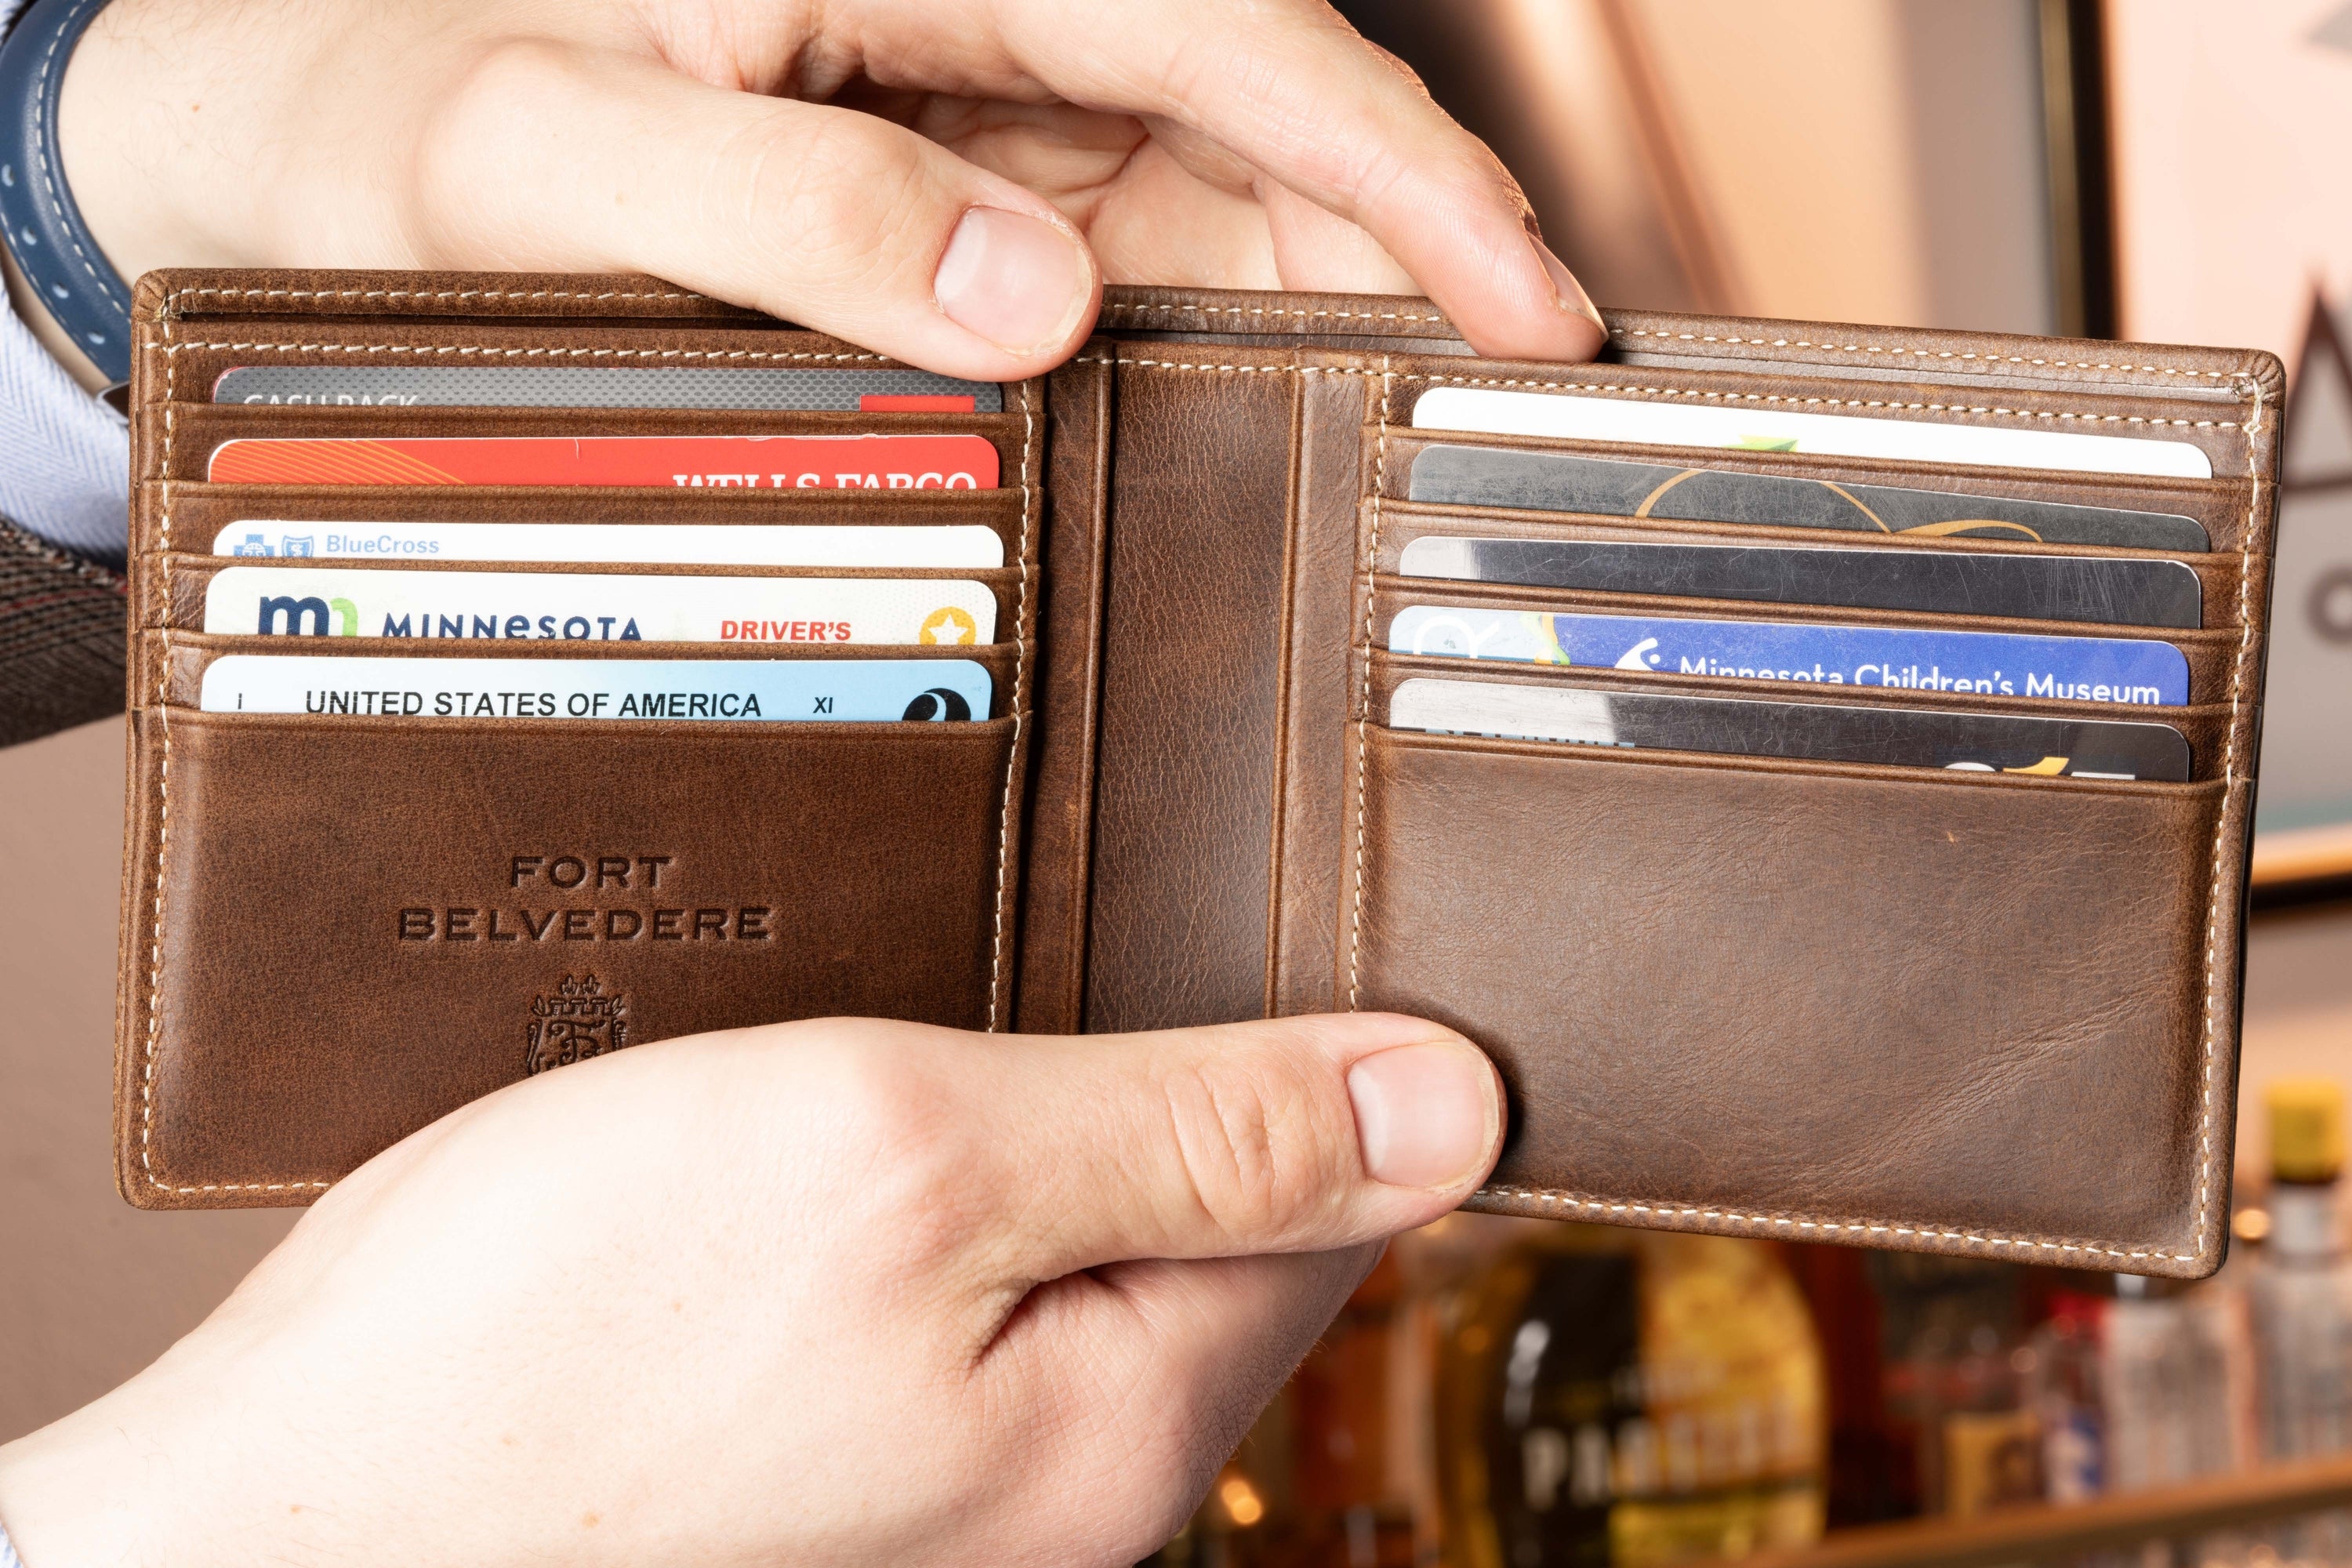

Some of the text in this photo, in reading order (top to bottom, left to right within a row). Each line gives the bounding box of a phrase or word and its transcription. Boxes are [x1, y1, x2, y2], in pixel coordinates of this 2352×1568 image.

[326, 535, 440, 554] BlueCross
[720, 620, 851, 641] DRIVER'S
[1855, 664, 2014, 695] Children's
[2026, 672, 2160, 705] Museum
[307, 691, 761, 717] UNITED STATES OF AMERICA
[813, 696, 833, 713] XI
[511, 855, 674, 888] FORT
[399, 908, 773, 941] BELVEDERE
